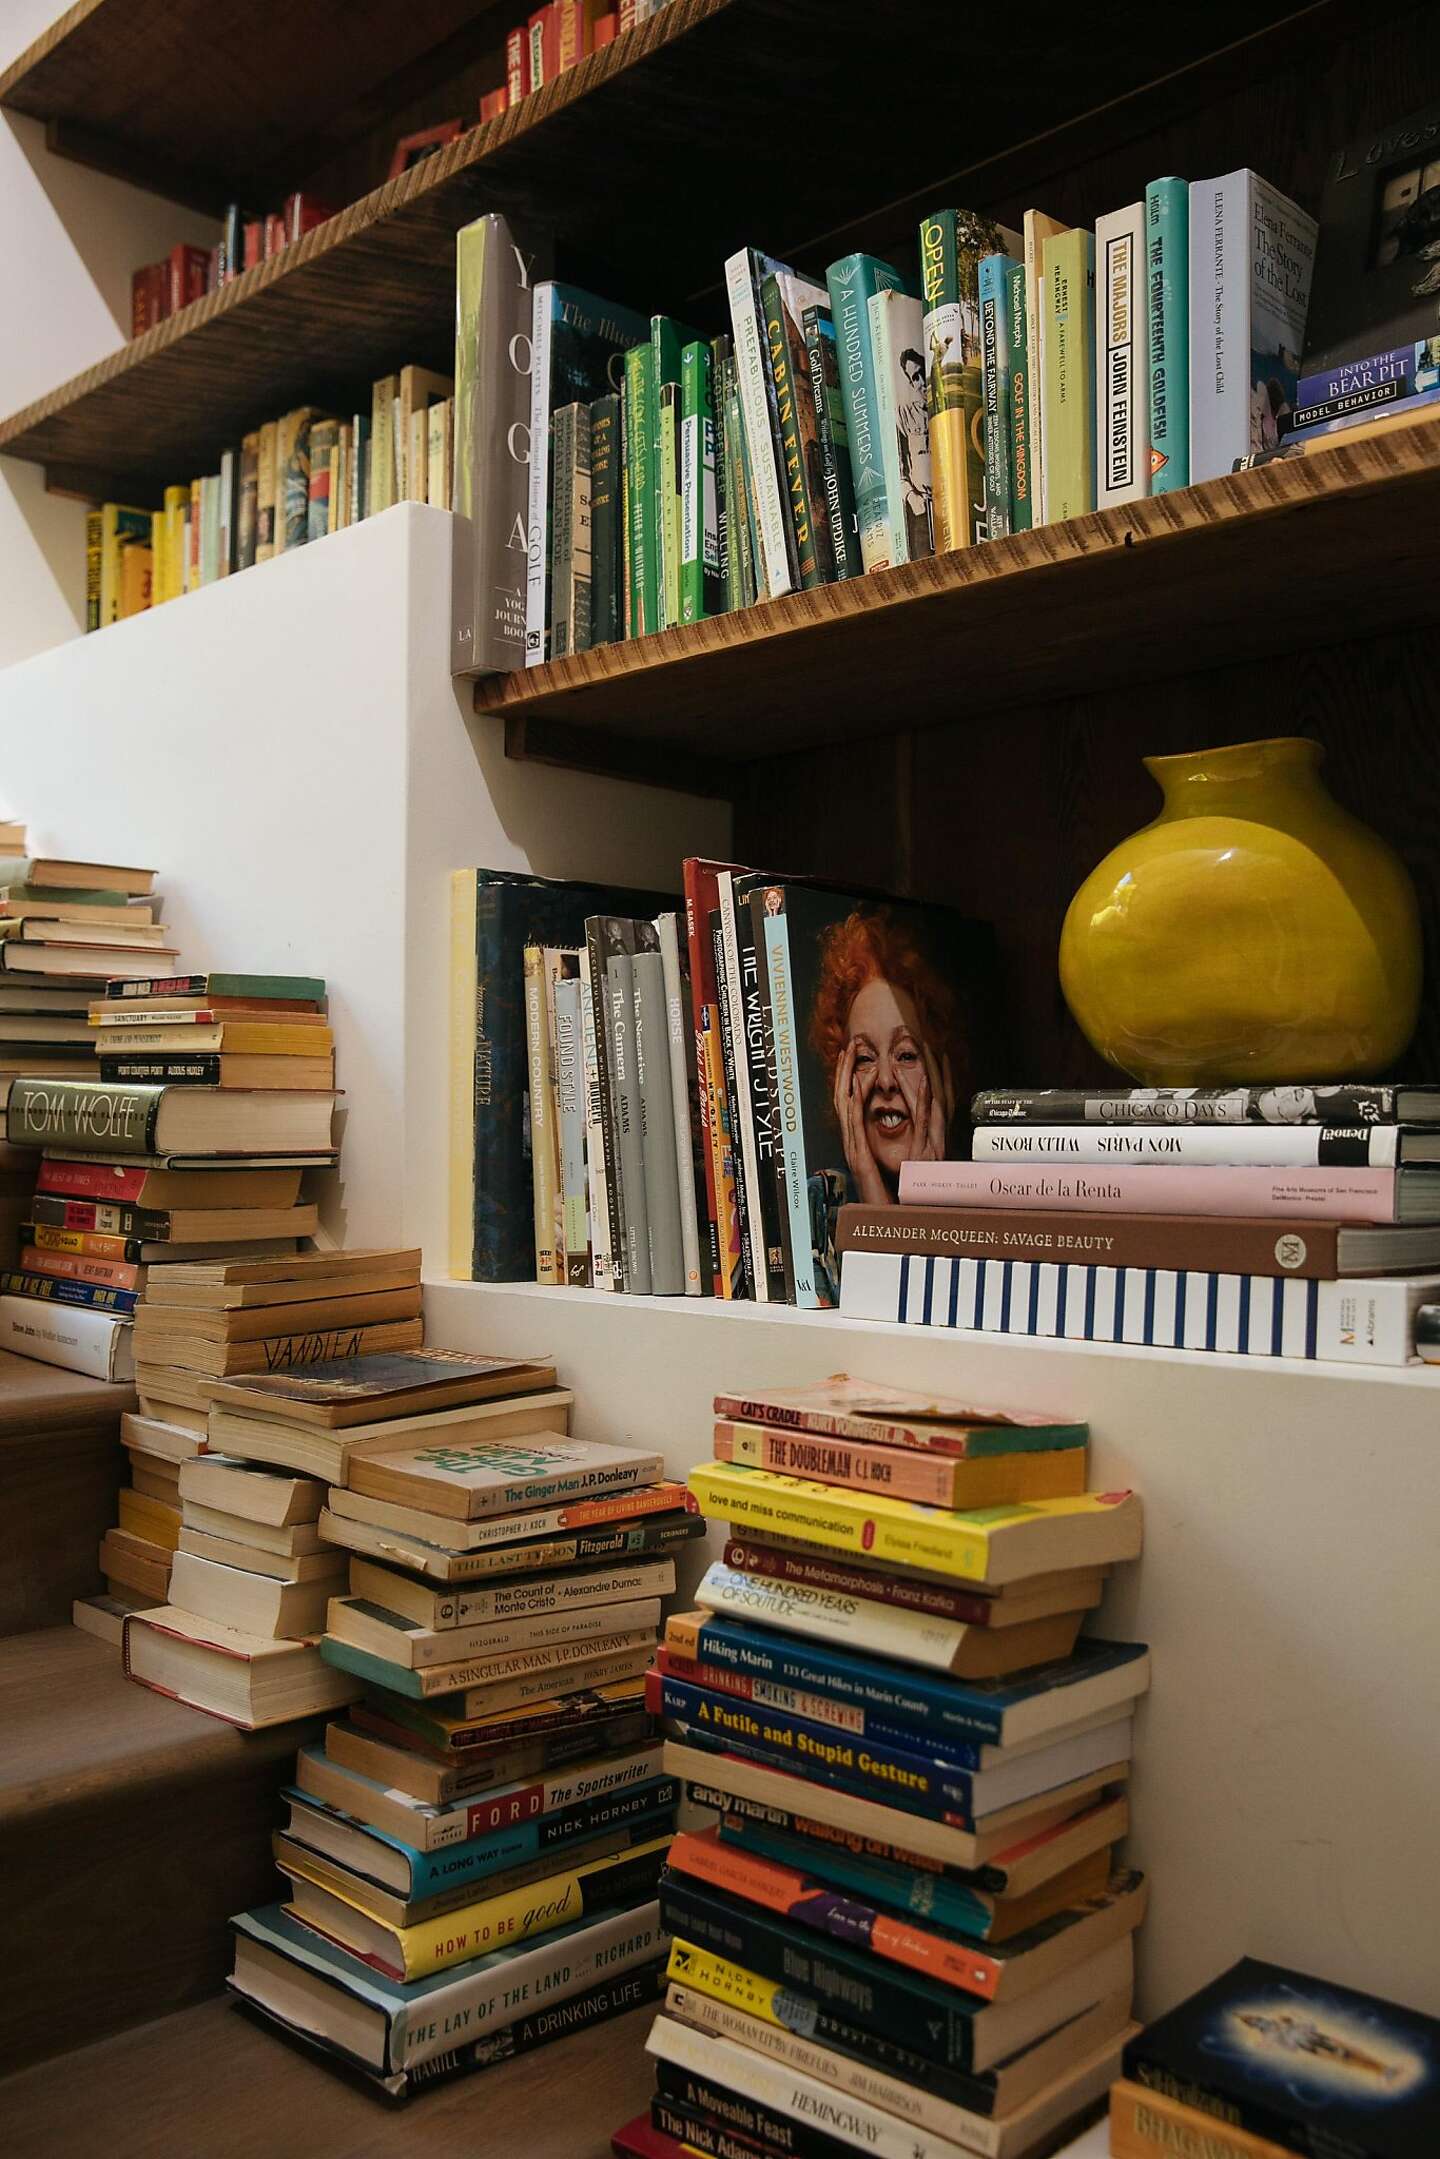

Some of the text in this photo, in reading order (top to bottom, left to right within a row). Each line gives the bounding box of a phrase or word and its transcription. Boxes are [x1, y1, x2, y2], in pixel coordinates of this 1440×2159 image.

[1214, 192, 1223, 225] ELENA
[925, 224, 944, 302] OPEN
[1214, 227, 1223, 281] FERRANTE
[1012, 275, 1022, 348] Michael Murphy
[984, 302, 997, 413] BEYOND THE FAIRWAY
[1151, 236, 1167, 440] THE FOURTEENTH GOLDFISH
[840, 290, 873, 465] A HUNDRED SUMMERS
[1112, 241, 1127, 483] THE MAJORS JOHN FEINSTEIN
[1215, 371, 1224, 394] Child
[1328, 360, 1409, 398] BEAR PIT
[1339, 352, 1395, 378] INTO THE
[1299, 386, 1391, 422] MODEL BEHAVIOR
[767, 320, 809, 545] CABIN FEVER
[1014, 372, 1027, 500] GOLF IN THE KINGDOM
[824, 474, 847, 564] JOHN UPDIKE
[719, 511, 730, 580] WILLING
[505, 597, 525, 611] YOG
[772, 944, 789, 1026] VIVIENNE
[670, 997, 683, 1044] HORSE
[528, 987, 544, 1128] MODERN COUNTRY
[558, 1014, 577, 1114] FOUND STYLE
[613, 989, 631, 1134] The Camera ADAMS
[779, 1027, 798, 1133] WESTWOOD
[24, 1092, 139, 1138] TOM WOLFE
[1099, 1101, 1226, 1119] CHICAGO DAYS
[991, 1136, 1182, 1152] MON PARIS WILLY RONIS
[990, 1177, 1121, 1198] Oscar de la Renta
[852, 1224, 927, 1240] ALEXANDER
[1002, 1231, 1052, 1247] SAVAGE
[1056, 1234, 1114, 1250] BEAUTY
[740, 1401, 800, 1426] CAT'S CRADLE
[769, 1438, 851, 1479] THE DOUBLEMAN
[505, 1467, 639, 1503] The Ginger Man J.P. Donleavy
[479, 1523, 522, 1541] CHRISTOPHER
[530, 1519, 547, 1531] KOCH
[579, 1510, 591, 1521] THE
[592, 1508, 605, 1519] YEAR
[606, 1506, 615, 1517] OF
[616, 1503, 634, 1515] LIVING
[709, 1492, 854, 1536] love and miss communication
[495, 1576, 643, 1604] The Count of Alexandre Dumas
[495, 1596, 556, 1616] Monte Cristo
[469, 1635, 510, 1650] FITZGERALD
[529, 1620, 602, 1640] THIS SIDE OF PARADISE
[703, 1637, 930, 1716] Hiking Marin 133 Great Hikes in Marin County
[698, 1702, 930, 1793] A Futile and Stupid Gesture
[551, 1761, 650, 1804] The Sportswriter
[471, 1794, 542, 1834] FORD
[547, 1796, 649, 1839] NICK HORNBY
[429, 1848, 501, 1880] A LONG WAY
[435, 1935, 468, 1959] HOW
[474, 1926, 491, 1945] TO
[497, 1916, 515, 1938] BE
[521, 1884, 571, 1936] good
[405, 1932, 650, 2049] THE LAY OF THE LAND RICHARD
[522, 1980, 643, 2041] A DRINKING LIFE
[699, 1970, 766, 2006] HORNBY
[792, 2089, 882, 2144] HEMINGWAY
